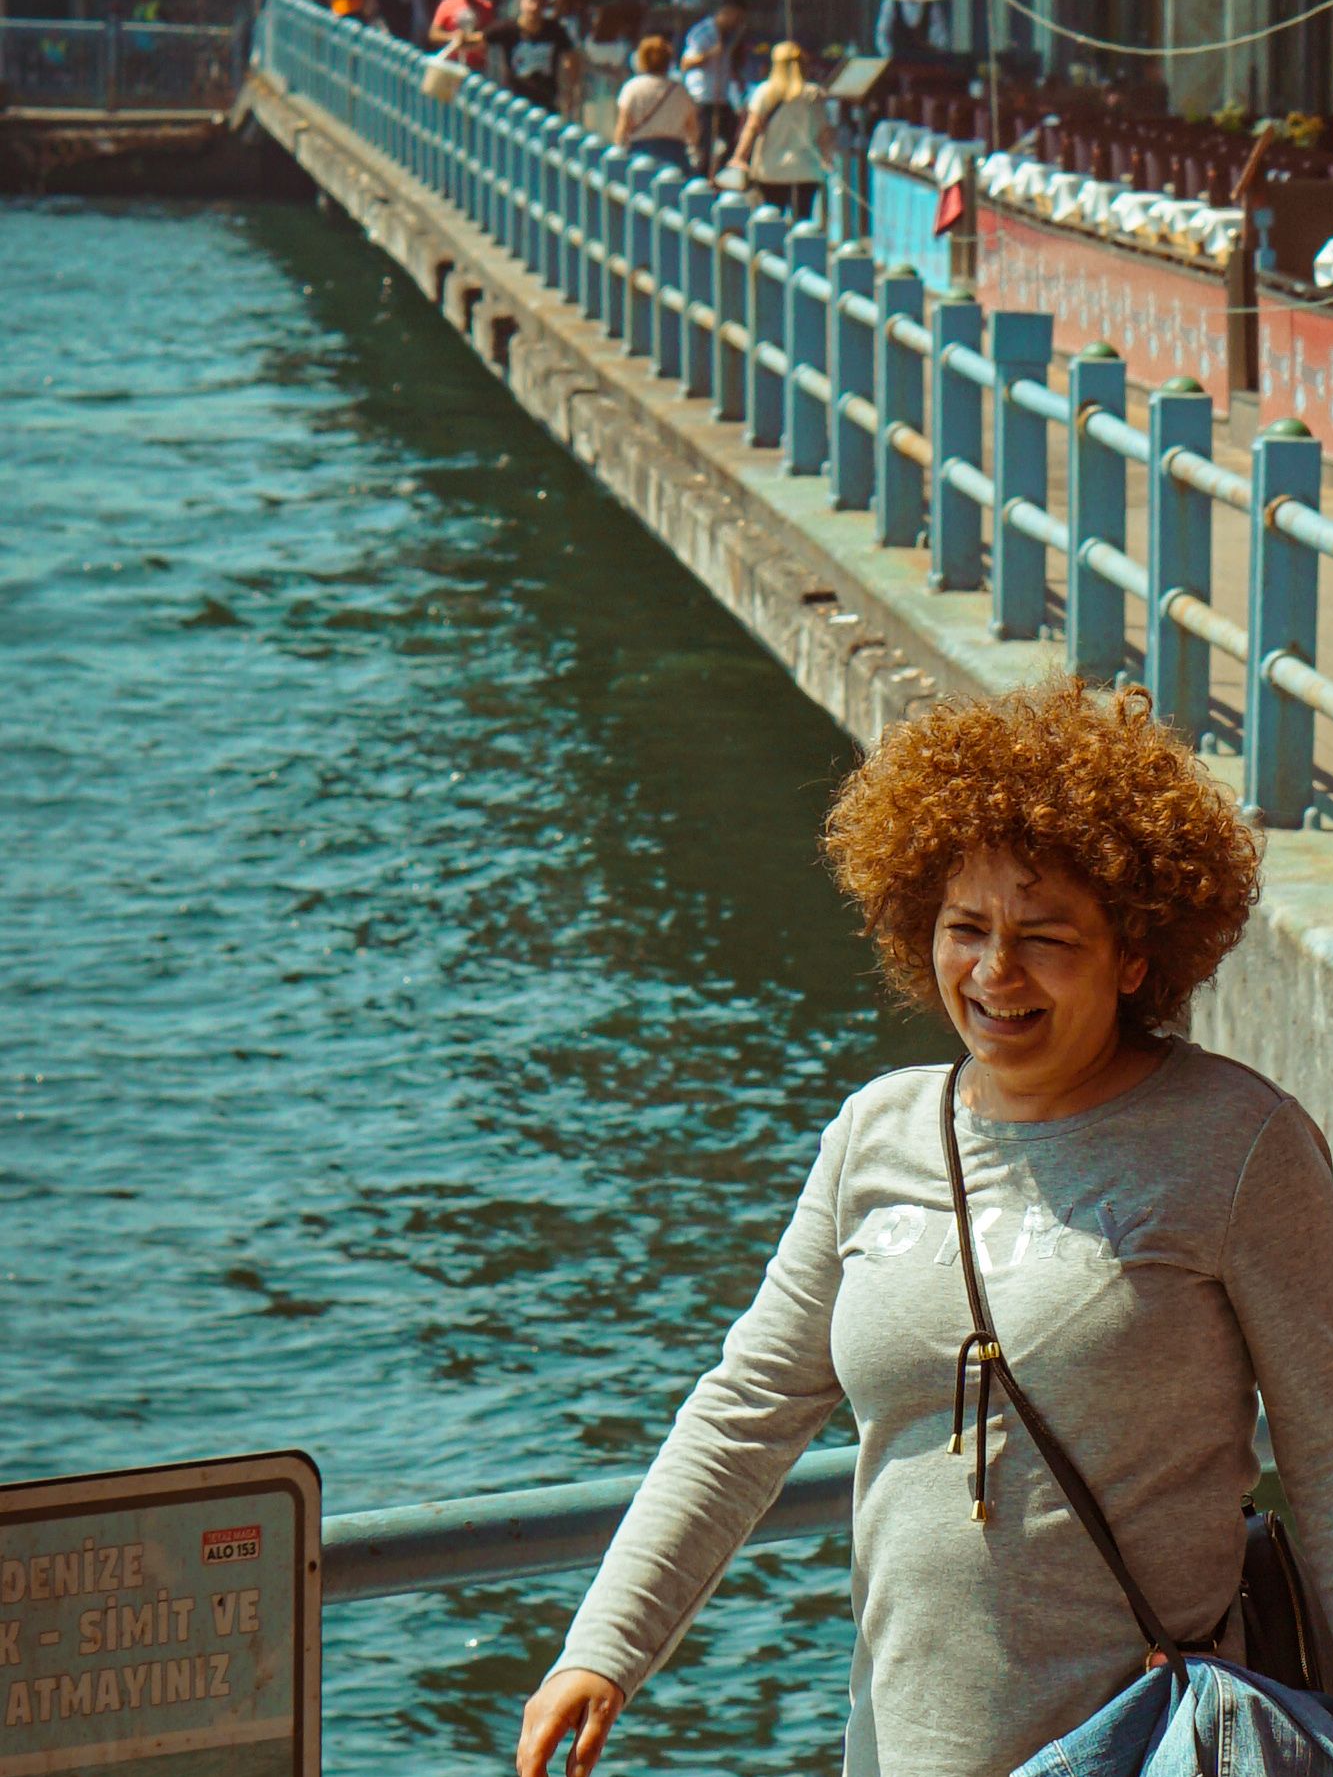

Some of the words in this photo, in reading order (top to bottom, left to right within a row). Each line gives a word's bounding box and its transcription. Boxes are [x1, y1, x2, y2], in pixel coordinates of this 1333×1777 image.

[0, 1536, 145, 1605] DENİZE
[207, 1544, 234, 1561] ALO
[237, 1541, 257, 1557] 153
[79, 1586, 195, 1656] SİMİT
[211, 1588, 260, 1638] VE
[4, 1652, 231, 1727] ATMAYINIZ
